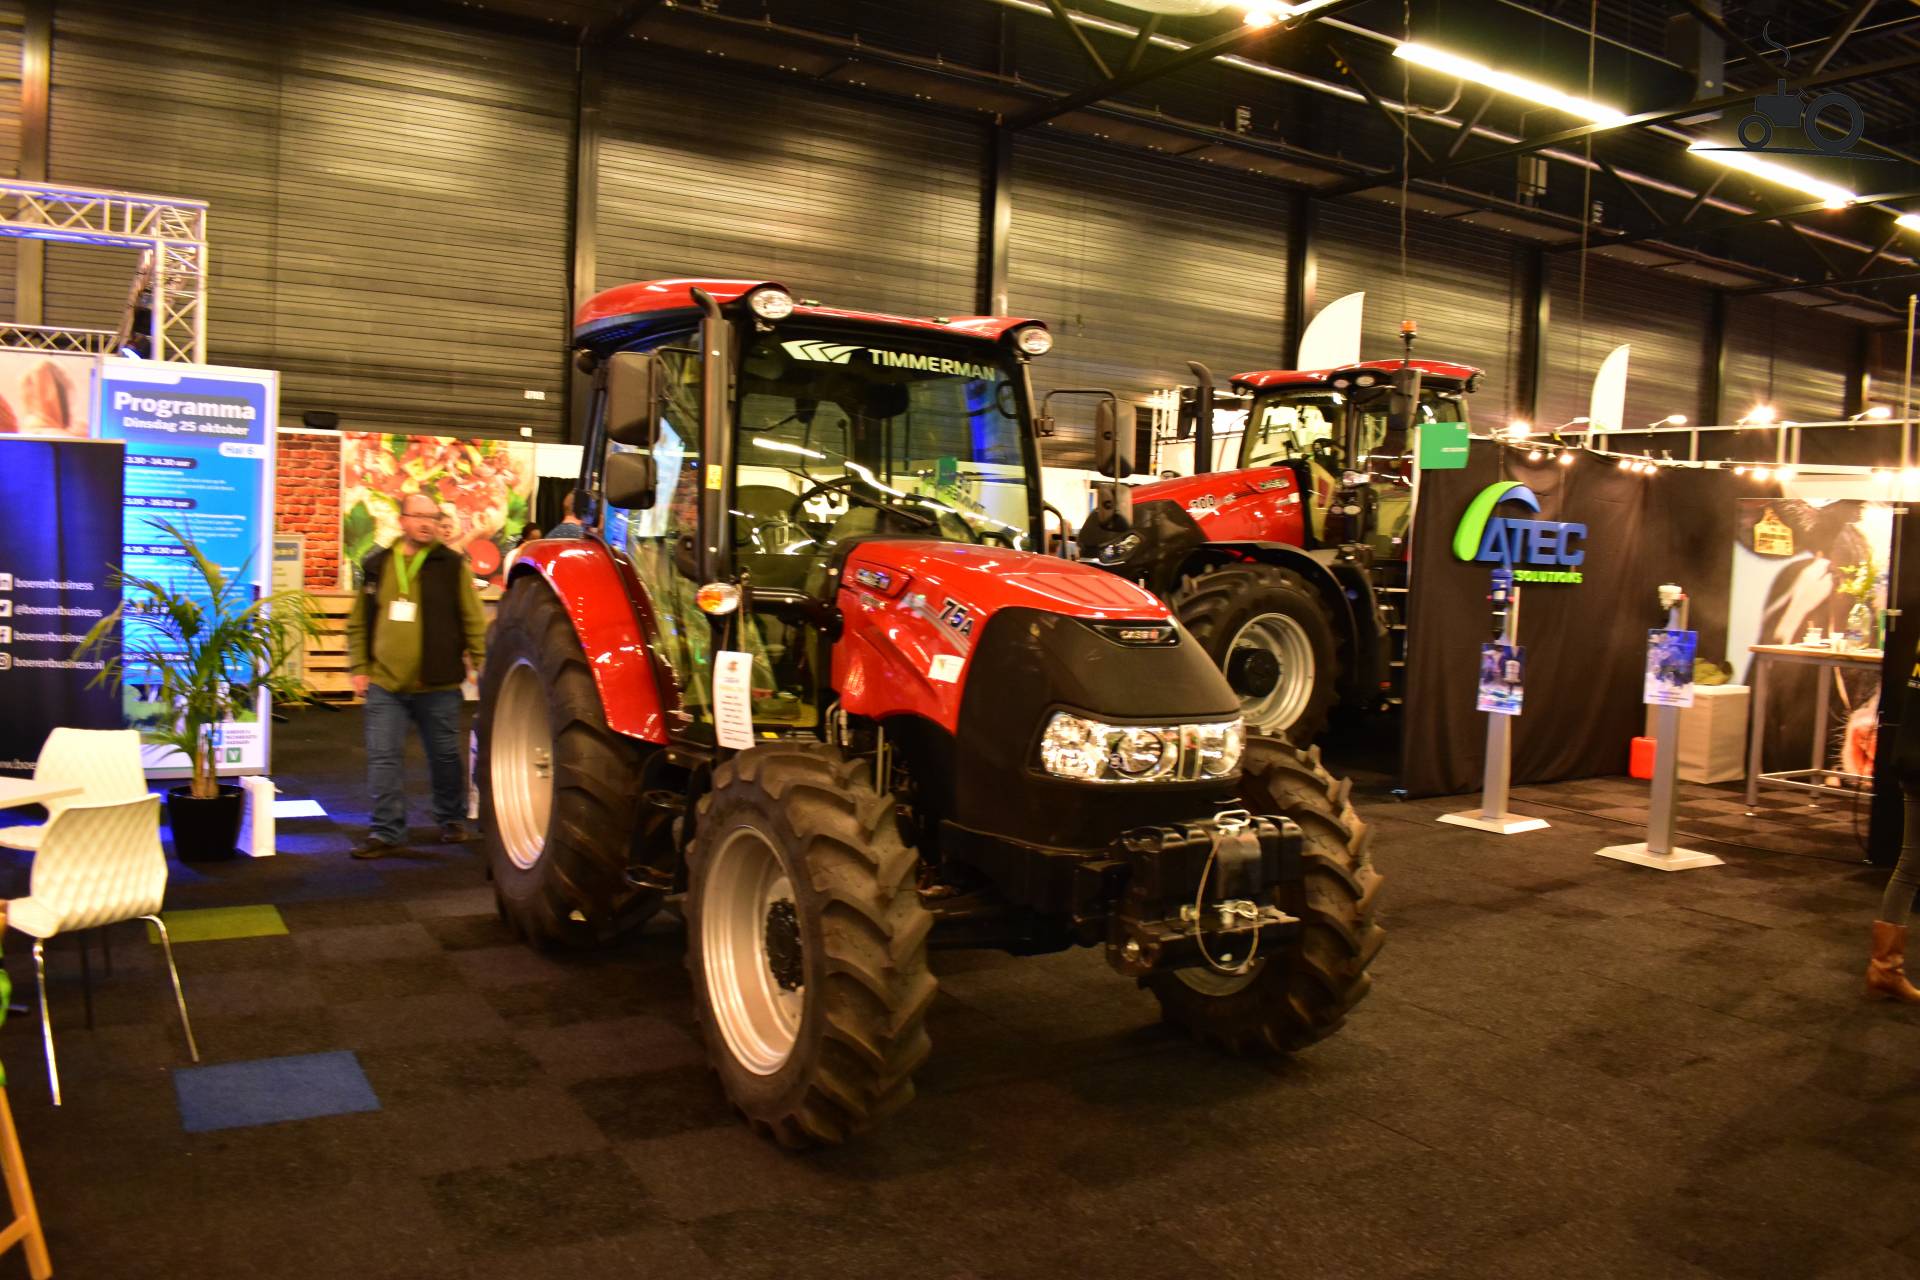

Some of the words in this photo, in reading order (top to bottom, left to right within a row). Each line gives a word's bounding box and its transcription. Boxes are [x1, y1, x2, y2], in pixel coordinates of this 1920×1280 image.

[867, 348, 995, 381] TIMMERMAN
[114, 391, 256, 420] Programma
[122, 416, 178, 432] Dinsdag
[179, 420, 197, 432] 25
[199, 422, 249, 435] oktober
[1474, 517, 1588, 567] ATEC
[14, 577, 95, 591] boerenbusiness
[14, 604, 103, 617] @boerenbusiness
[938, 596, 975, 636] 75A
